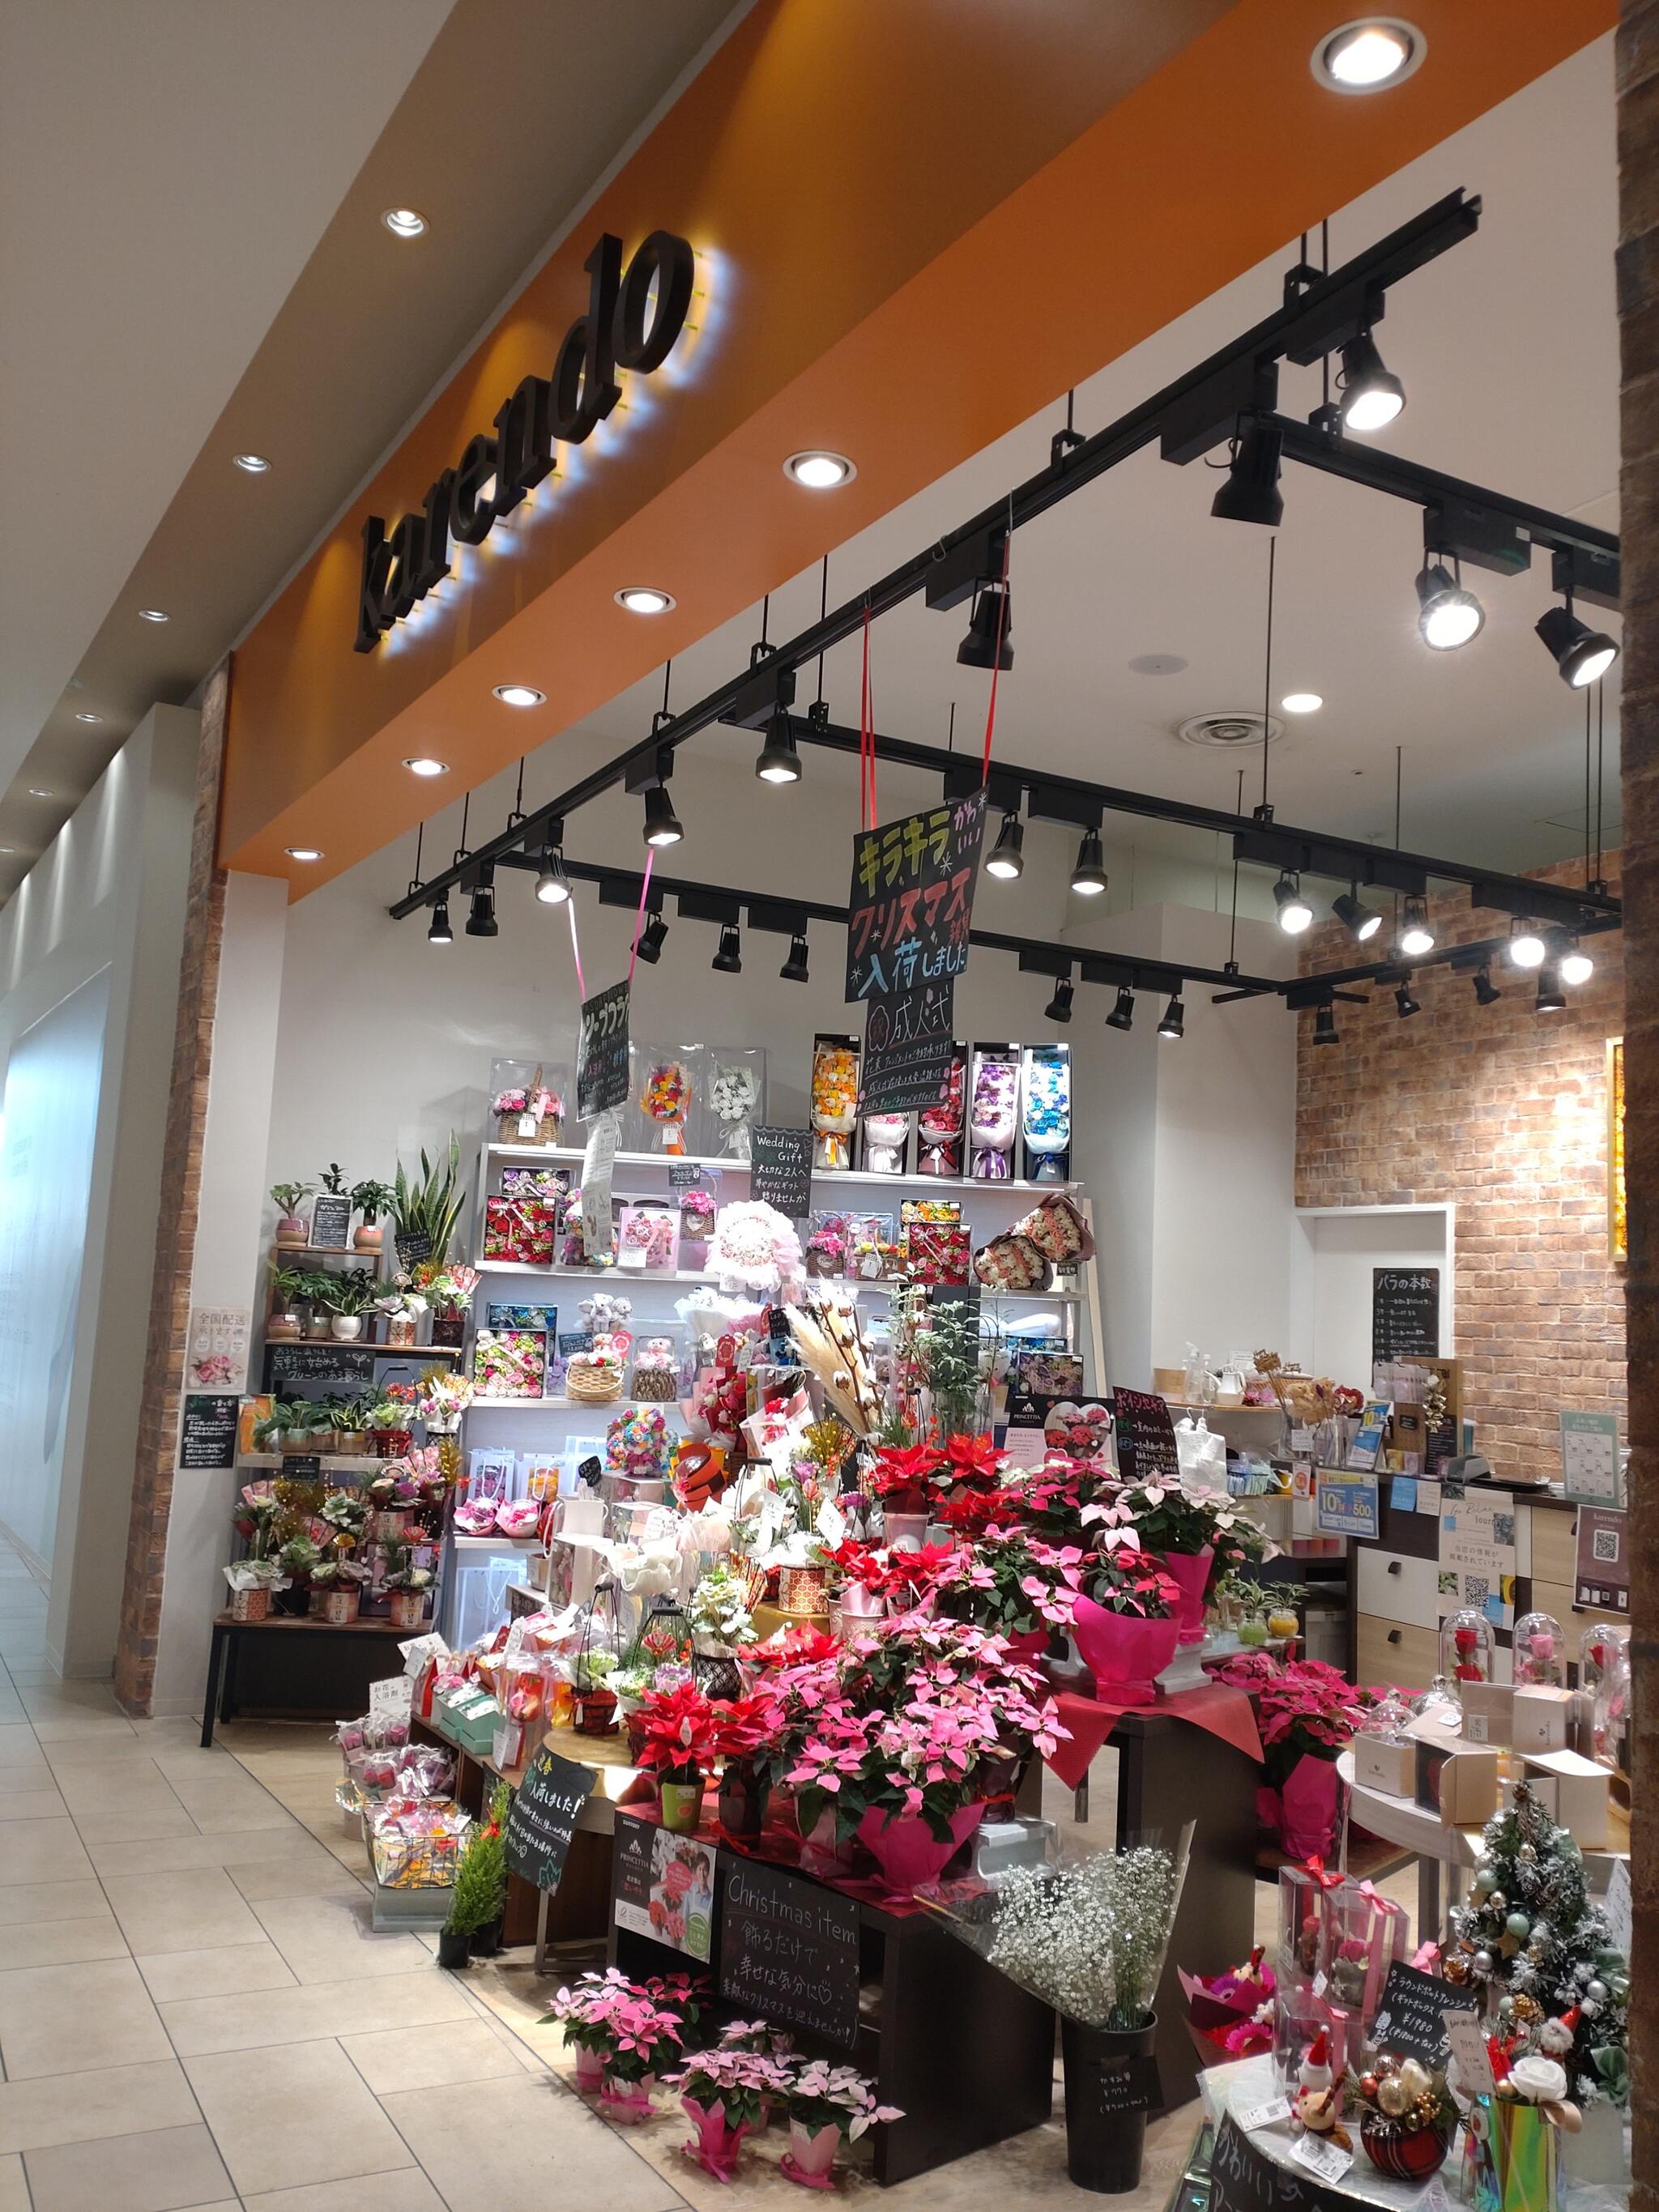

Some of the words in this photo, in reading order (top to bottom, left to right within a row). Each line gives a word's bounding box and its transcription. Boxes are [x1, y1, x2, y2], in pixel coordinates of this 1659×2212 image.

[354, 229, 695, 654] karendo
[859, 811, 951, 898] キラキラ
[851, 867, 971, 960] クリスマス
[889, 984, 951, 1043] 成人式
[757, 1135, 800, 1153] Wedding
[778, 1152, 803, 1164] Gift
[757, 1163, 807, 1178] 大切な2人へ
[1377, 1273, 1432, 1291] バラの本数
[199, 1312, 247, 1326] 全国配送
[273, 1355, 340, 1370] 気軽に始める
[288, 1367, 369, 1383] グリーンのある暮らし
[1116, 1390, 1165, 1413] ポインセチア
[1449, 1553, 1504, 1568] 掲載されています
[1456, 1545, 1499, 1558] 当店の情報が
[374, 1690, 399, 1702] 入浴剤
[729, 1873, 812, 1929] Christmas
[818, 1906, 856, 1945] item
[741, 1920, 818, 1967] 飾るだけで
[740, 1954, 818, 2001] 幸せな気分に
[1399, 1976, 1467, 2009] ラウンドポットアレンジ
[1402, 2012, 1433, 2033] ¥1980
